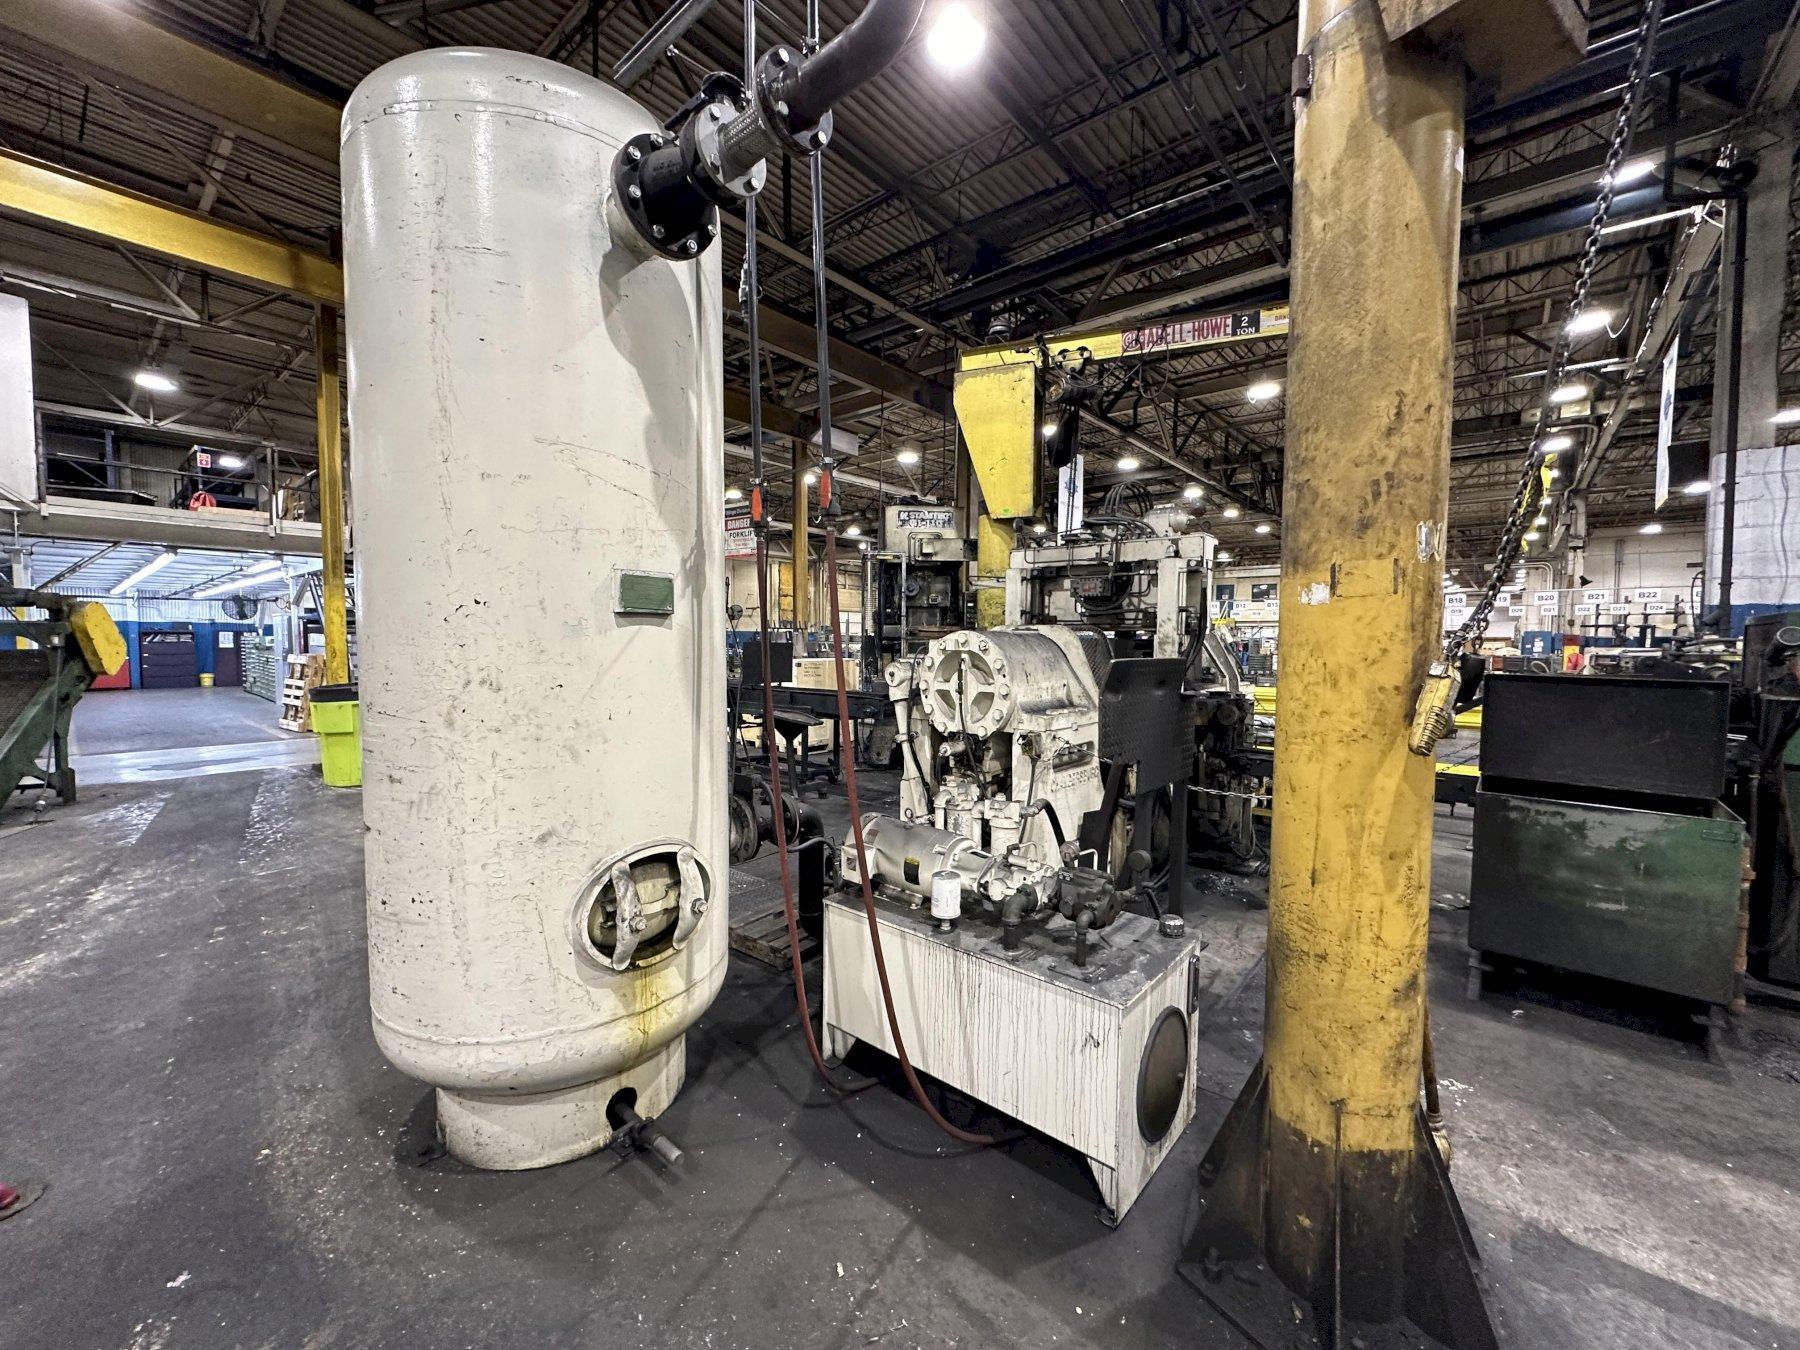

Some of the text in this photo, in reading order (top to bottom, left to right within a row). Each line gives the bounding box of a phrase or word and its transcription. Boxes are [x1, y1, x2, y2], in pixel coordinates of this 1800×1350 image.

[1241, 316, 1249, 326] 2
[1236, 327, 1256, 336] TON
[729, 530, 753, 539] FORKLIF
